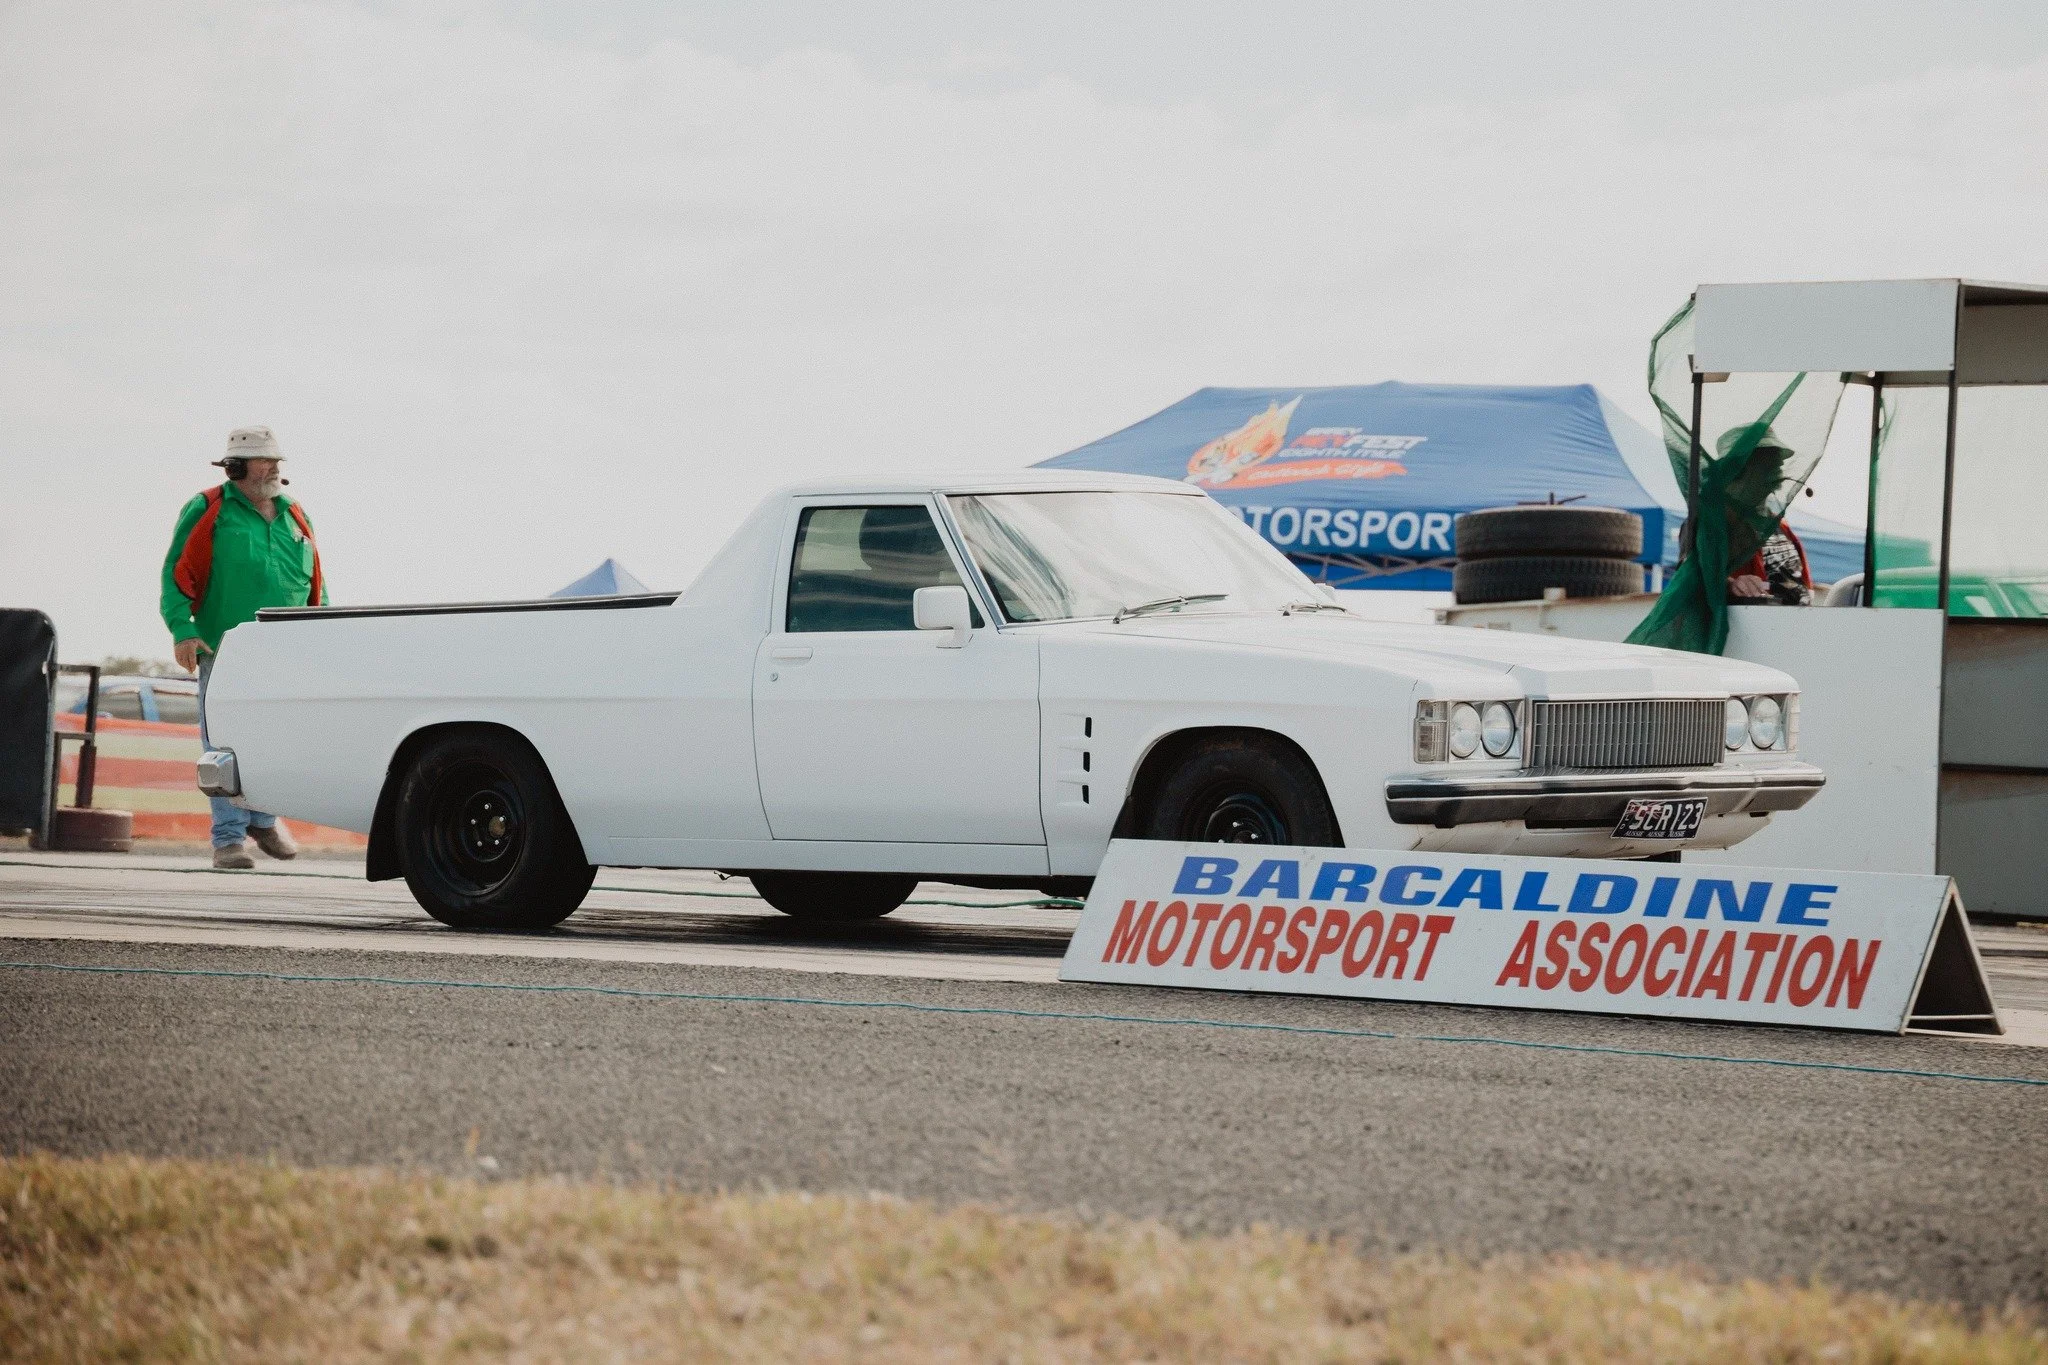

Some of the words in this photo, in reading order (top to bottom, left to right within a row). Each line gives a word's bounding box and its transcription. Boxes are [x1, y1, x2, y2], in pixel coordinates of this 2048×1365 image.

[1231, 506, 1457, 552] TORSPOR
[1172, 855, 1838, 927] BARCALDINE
[1102, 900, 1455, 981] MOTORSPORT
[1495, 920, 1882, 1010] ASSOCIATION
